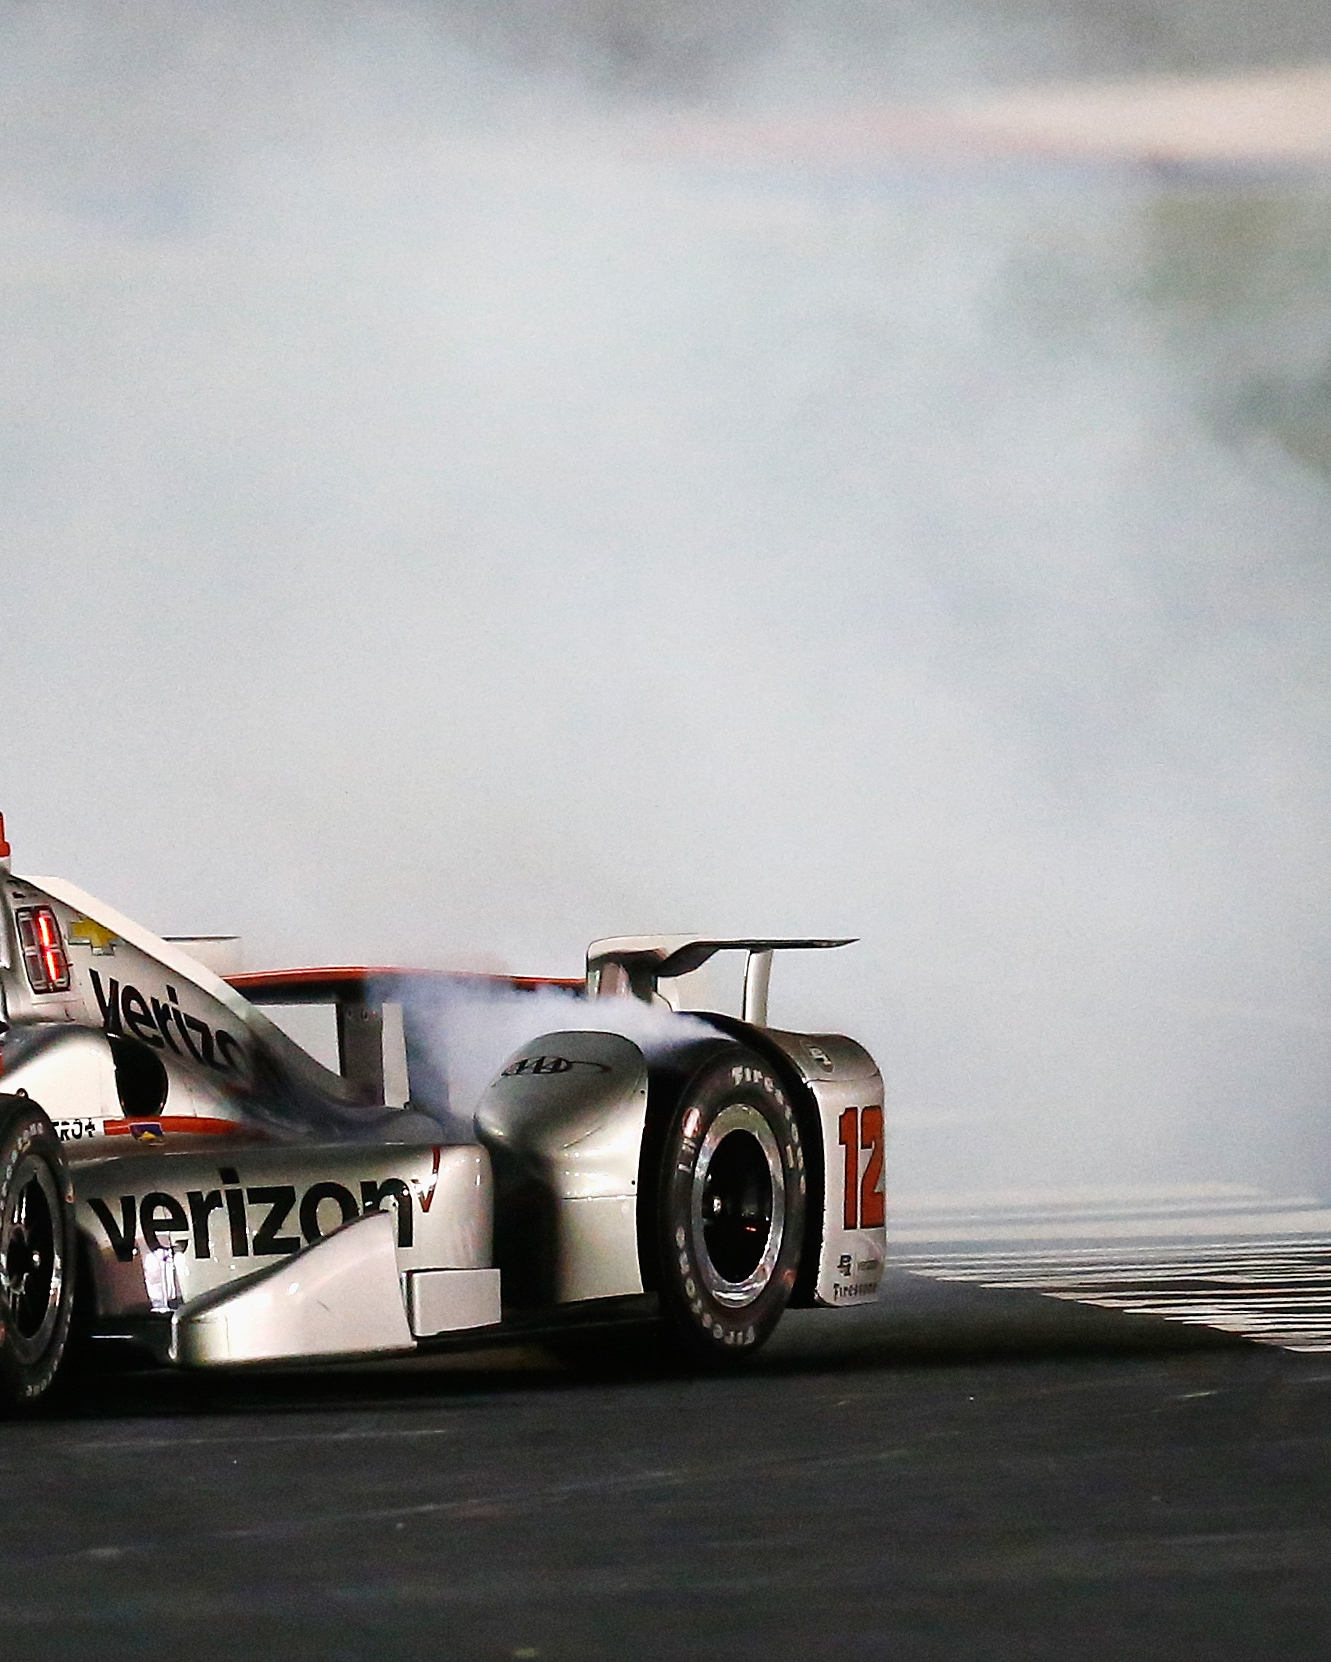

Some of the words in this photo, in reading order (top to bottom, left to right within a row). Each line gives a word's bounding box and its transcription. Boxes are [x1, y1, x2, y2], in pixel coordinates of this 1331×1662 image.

[88, 966, 247, 1073] verizo
[87, 1165, 415, 1262] verizon
[838, 1105, 886, 1231] 12
